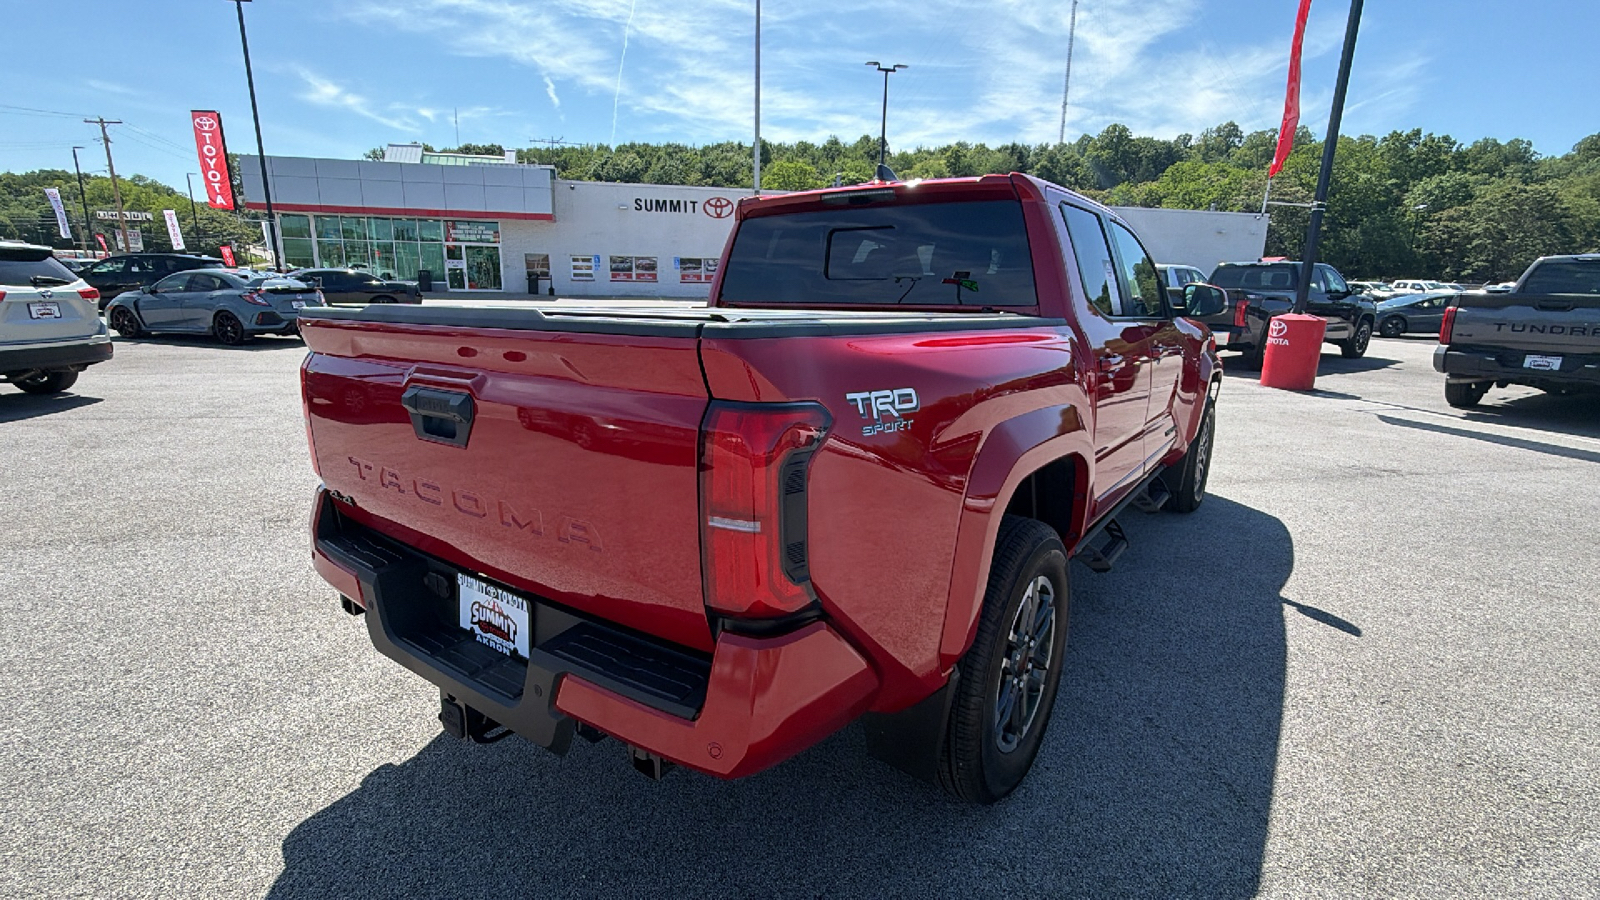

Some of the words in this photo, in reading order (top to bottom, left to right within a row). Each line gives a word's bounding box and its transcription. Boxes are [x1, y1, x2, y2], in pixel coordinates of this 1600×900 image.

[202, 132, 227, 205] TOYOTA
[634, 198, 698, 213] SUMMIT
[845, 387, 919, 420] TRD
[861, 419, 914, 437] SPORT
[348, 456, 603, 552] TACOMA
[457, 573, 488, 595] SUMMIT
[497, 588, 528, 613] TOYOTA
[471, 601, 516, 641] SUMMIT
[476, 634, 511, 656] AKRON
